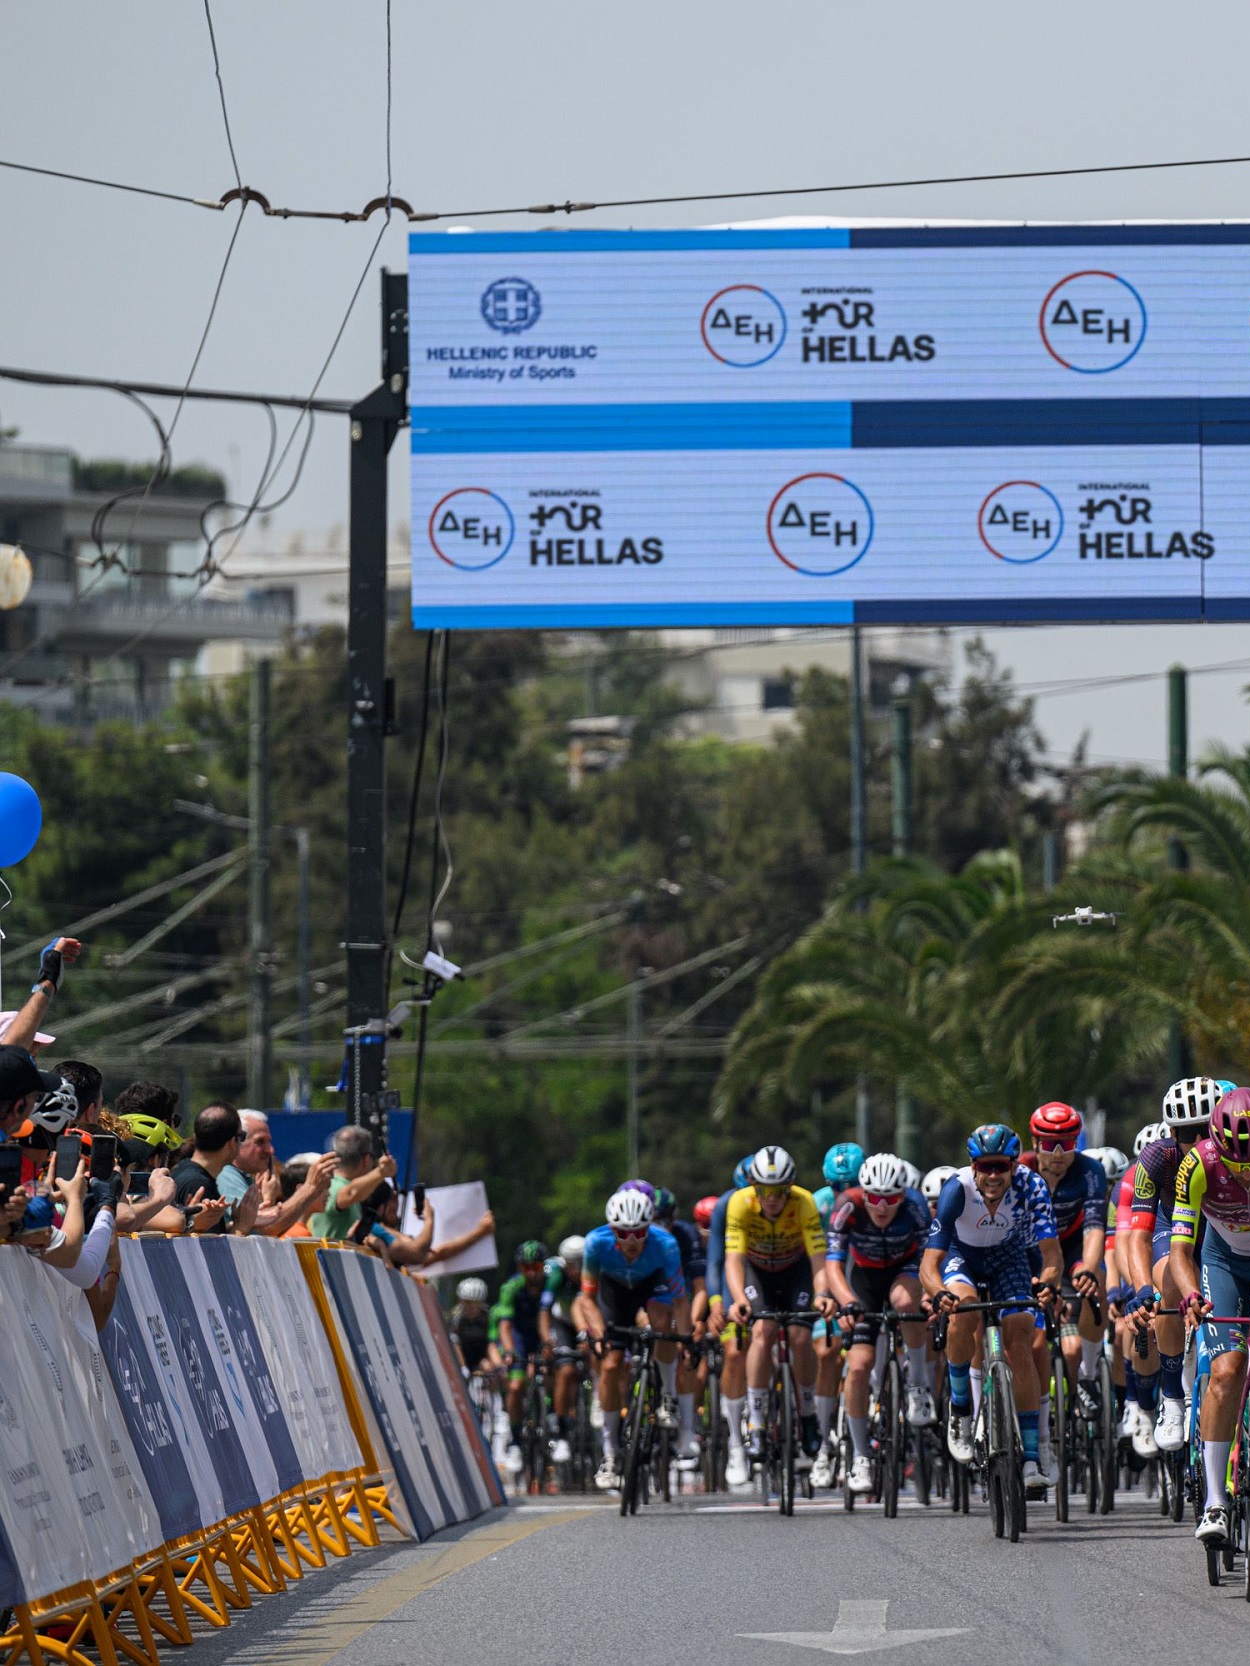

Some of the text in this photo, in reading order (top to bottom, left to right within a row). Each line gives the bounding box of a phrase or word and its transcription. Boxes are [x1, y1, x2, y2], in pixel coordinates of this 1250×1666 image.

[801, 287, 873, 295] INTERNATIONAL
[426, 345, 597, 361] HELLENIC REPUBLIC
[801, 334, 936, 364] HELLAS
[449, 365, 576, 382] Ministry of Sports
[529, 489, 600, 498] INTERNATIONAL
[1078, 482, 1150, 491] INTERNATIONAL
[529, 537, 664, 567] HELLAS
[1078, 529, 1216, 561] HELLAS
